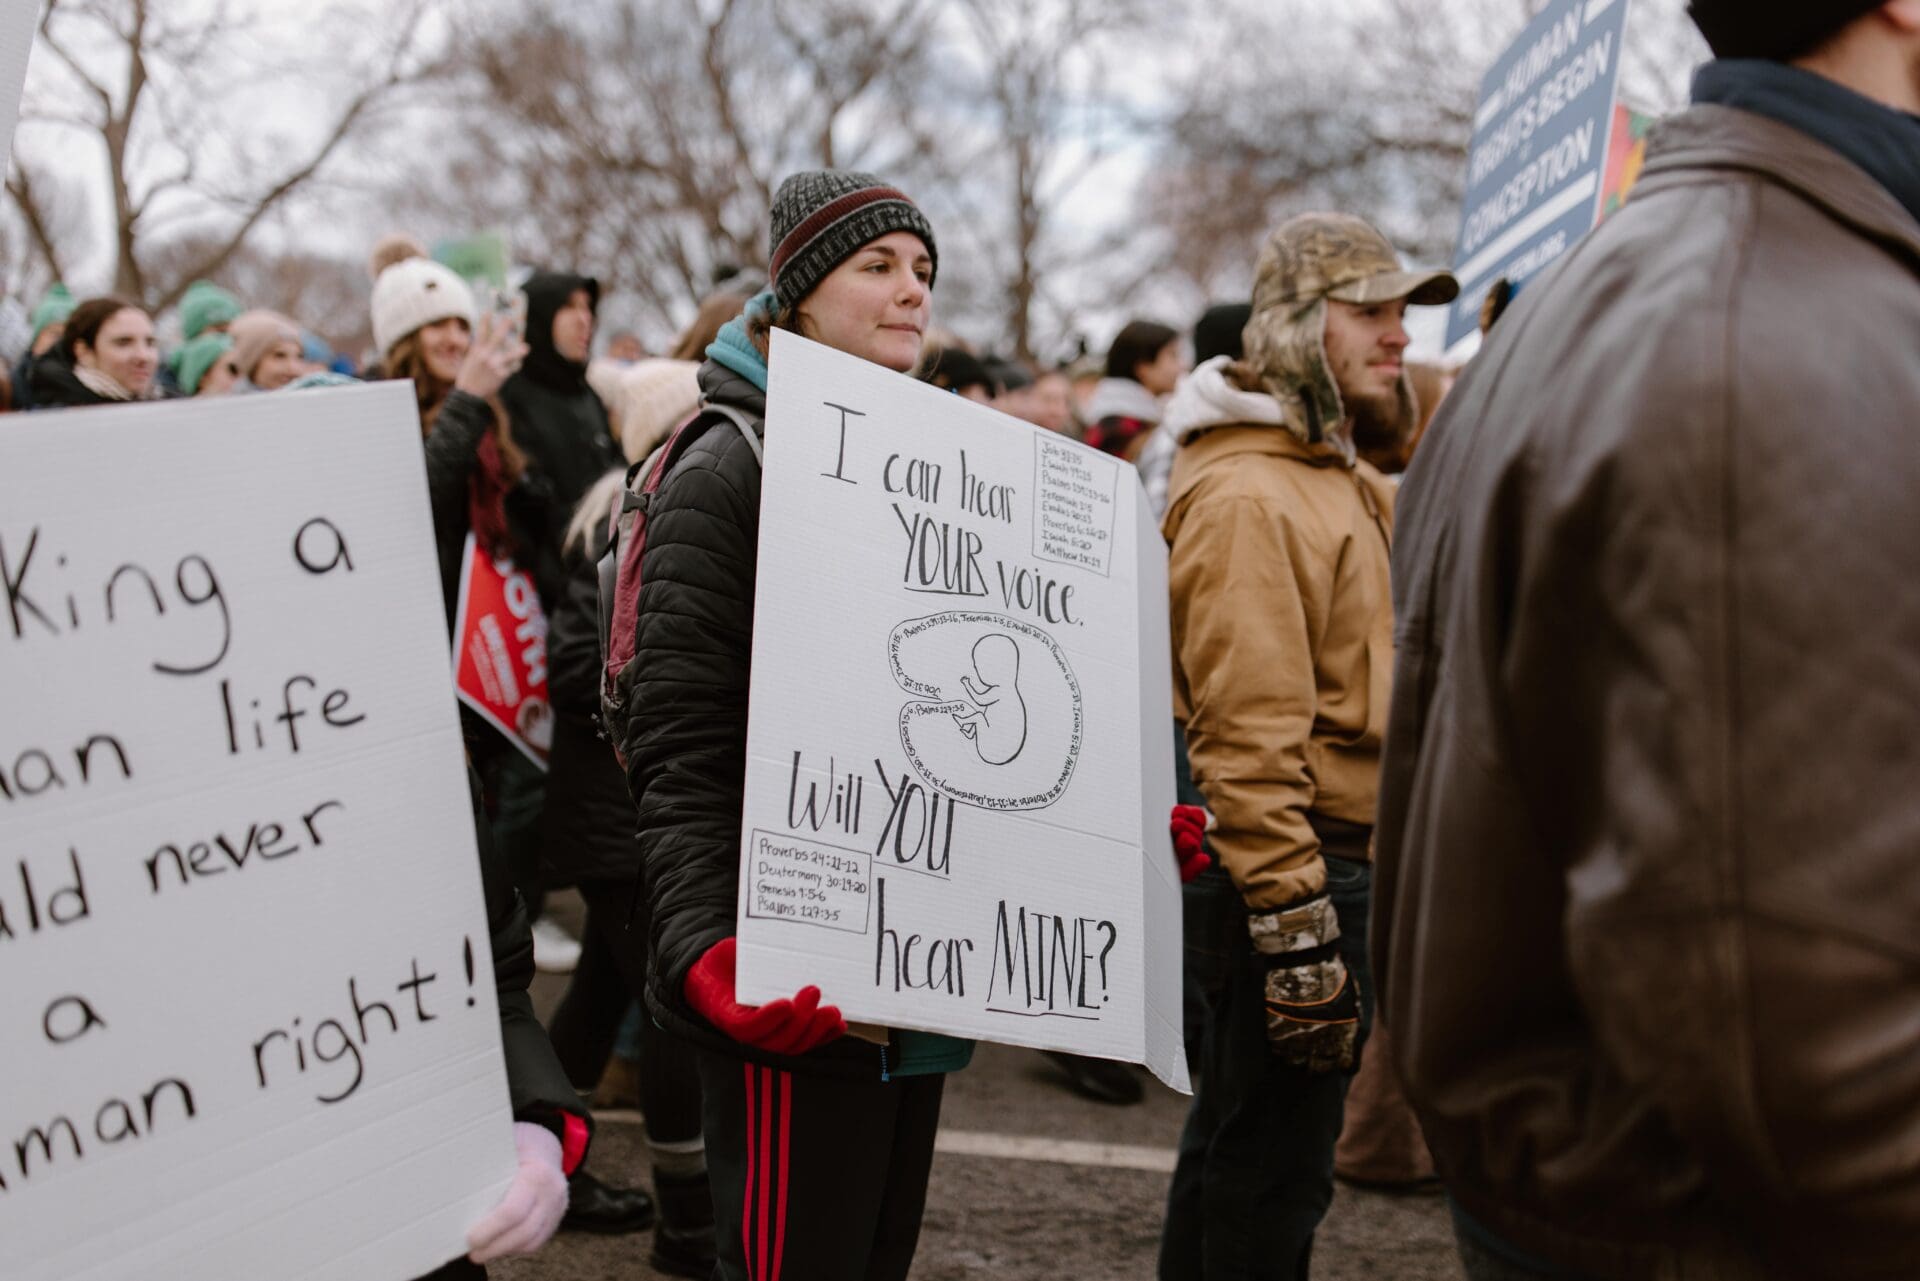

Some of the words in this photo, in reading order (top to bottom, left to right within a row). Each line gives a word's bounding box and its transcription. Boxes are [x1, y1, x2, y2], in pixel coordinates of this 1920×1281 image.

[821, 401, 867, 485] I
[883, 452, 942, 504] can
[959, 448, 1016, 524] hear
[293, 516, 355, 575] a
[892, 503, 989, 596] YOUR
[997, 560, 1084, 627] voice.
[217, 675, 367, 754] life
[143, 800, 346, 895] never
[759, 837, 809, 862] Proverbs
[810, 851, 860, 875] 24:11-12
[787, 750, 864, 835] Will
[874, 758, 956, 876] YOU
[756, 879, 797, 898] Genesis
[757, 895, 796, 916] Psalms
[875, 877, 975, 998] hear
[985, 899, 1118, 1011] MINE?
[42, 994, 107, 1045] a
[0, 1077, 197, 1192] man
